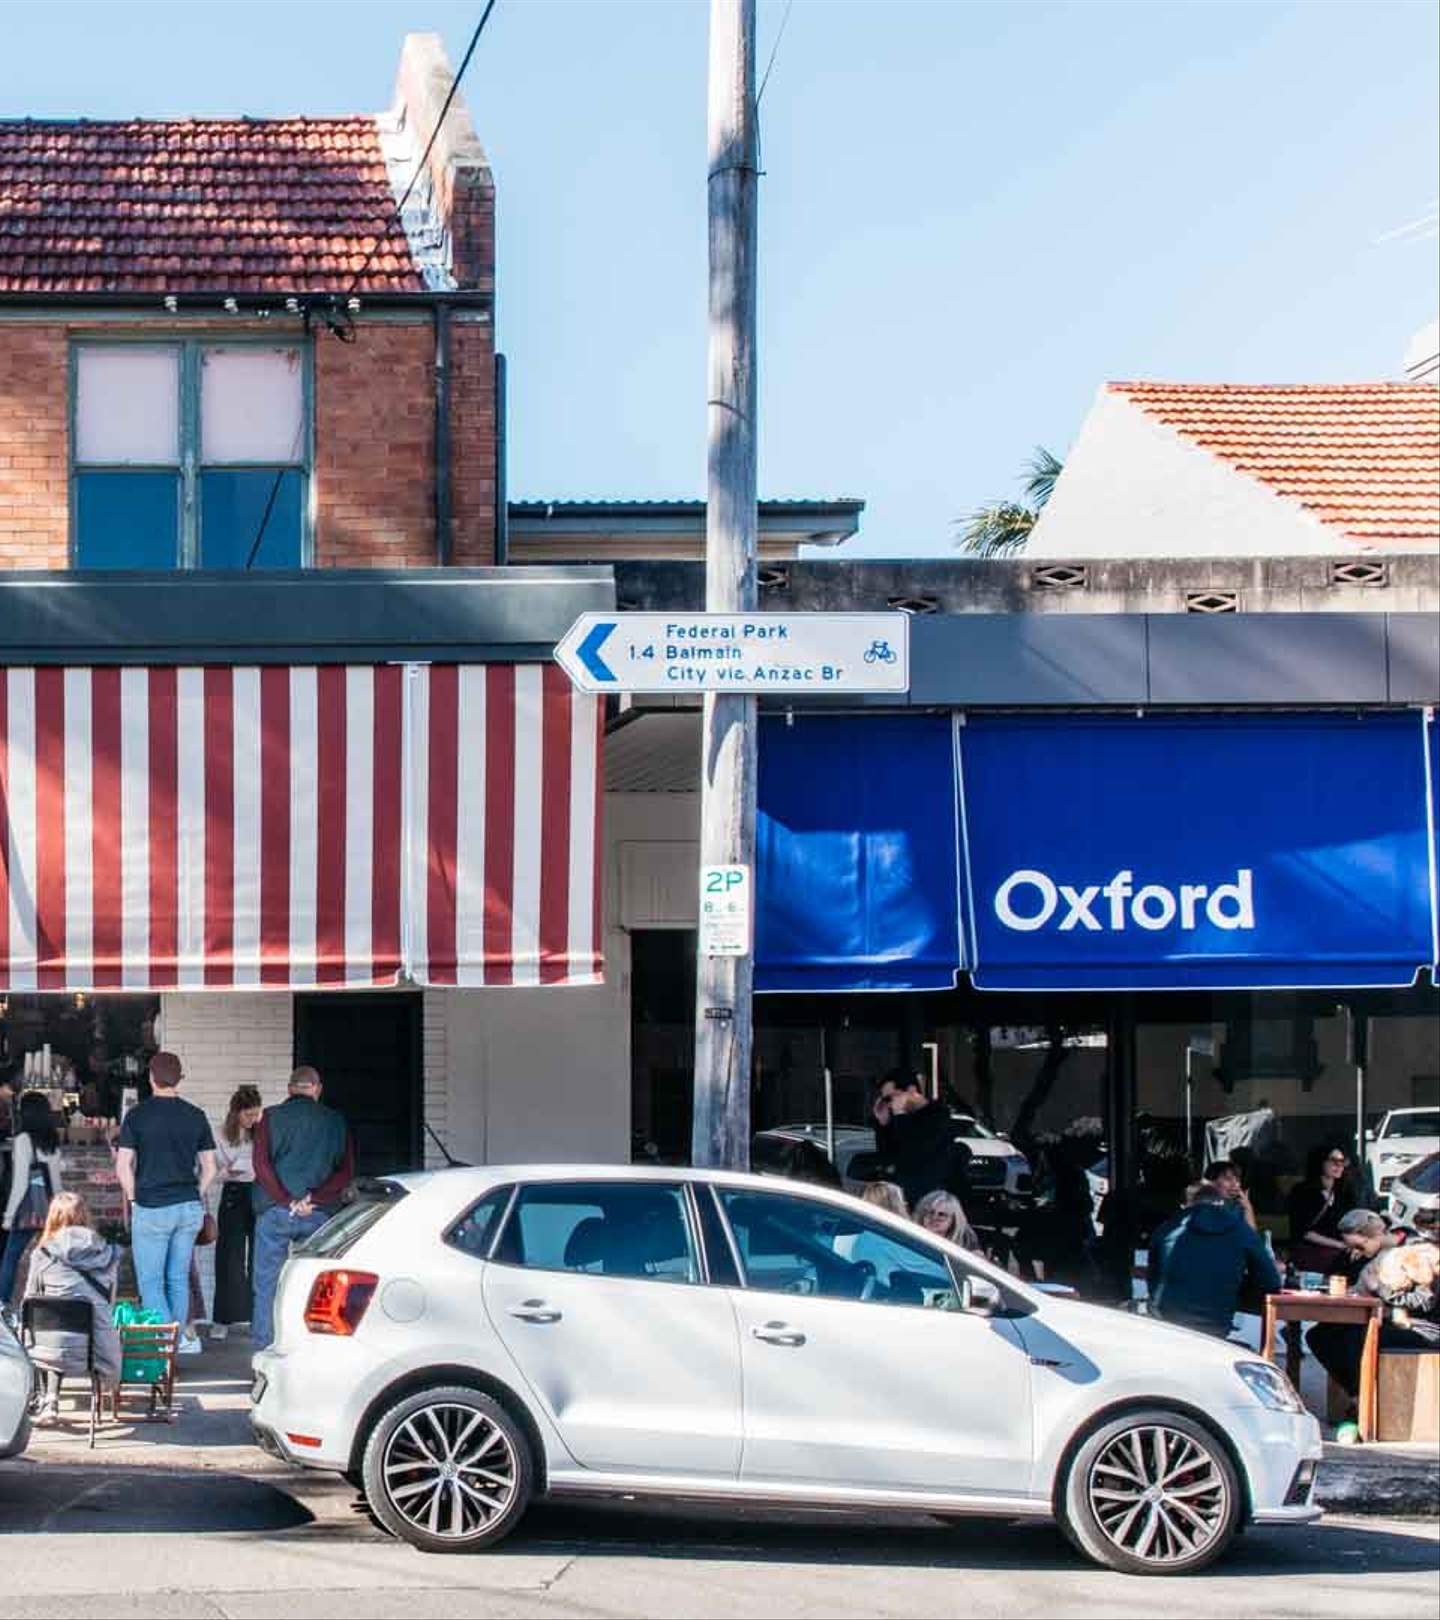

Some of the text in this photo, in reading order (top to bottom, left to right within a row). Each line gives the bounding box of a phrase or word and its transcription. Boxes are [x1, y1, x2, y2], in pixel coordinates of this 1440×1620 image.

[666, 623, 788, 639] Federal Park
[666, 644, 742, 660] Balmain
[666, 665, 707, 683] City
[753, 665, 815, 681] Anzac
[821, 665, 844, 681] Br
[706, 871, 744, 893] 2P
[994, 868, 1257, 932] Oxford
